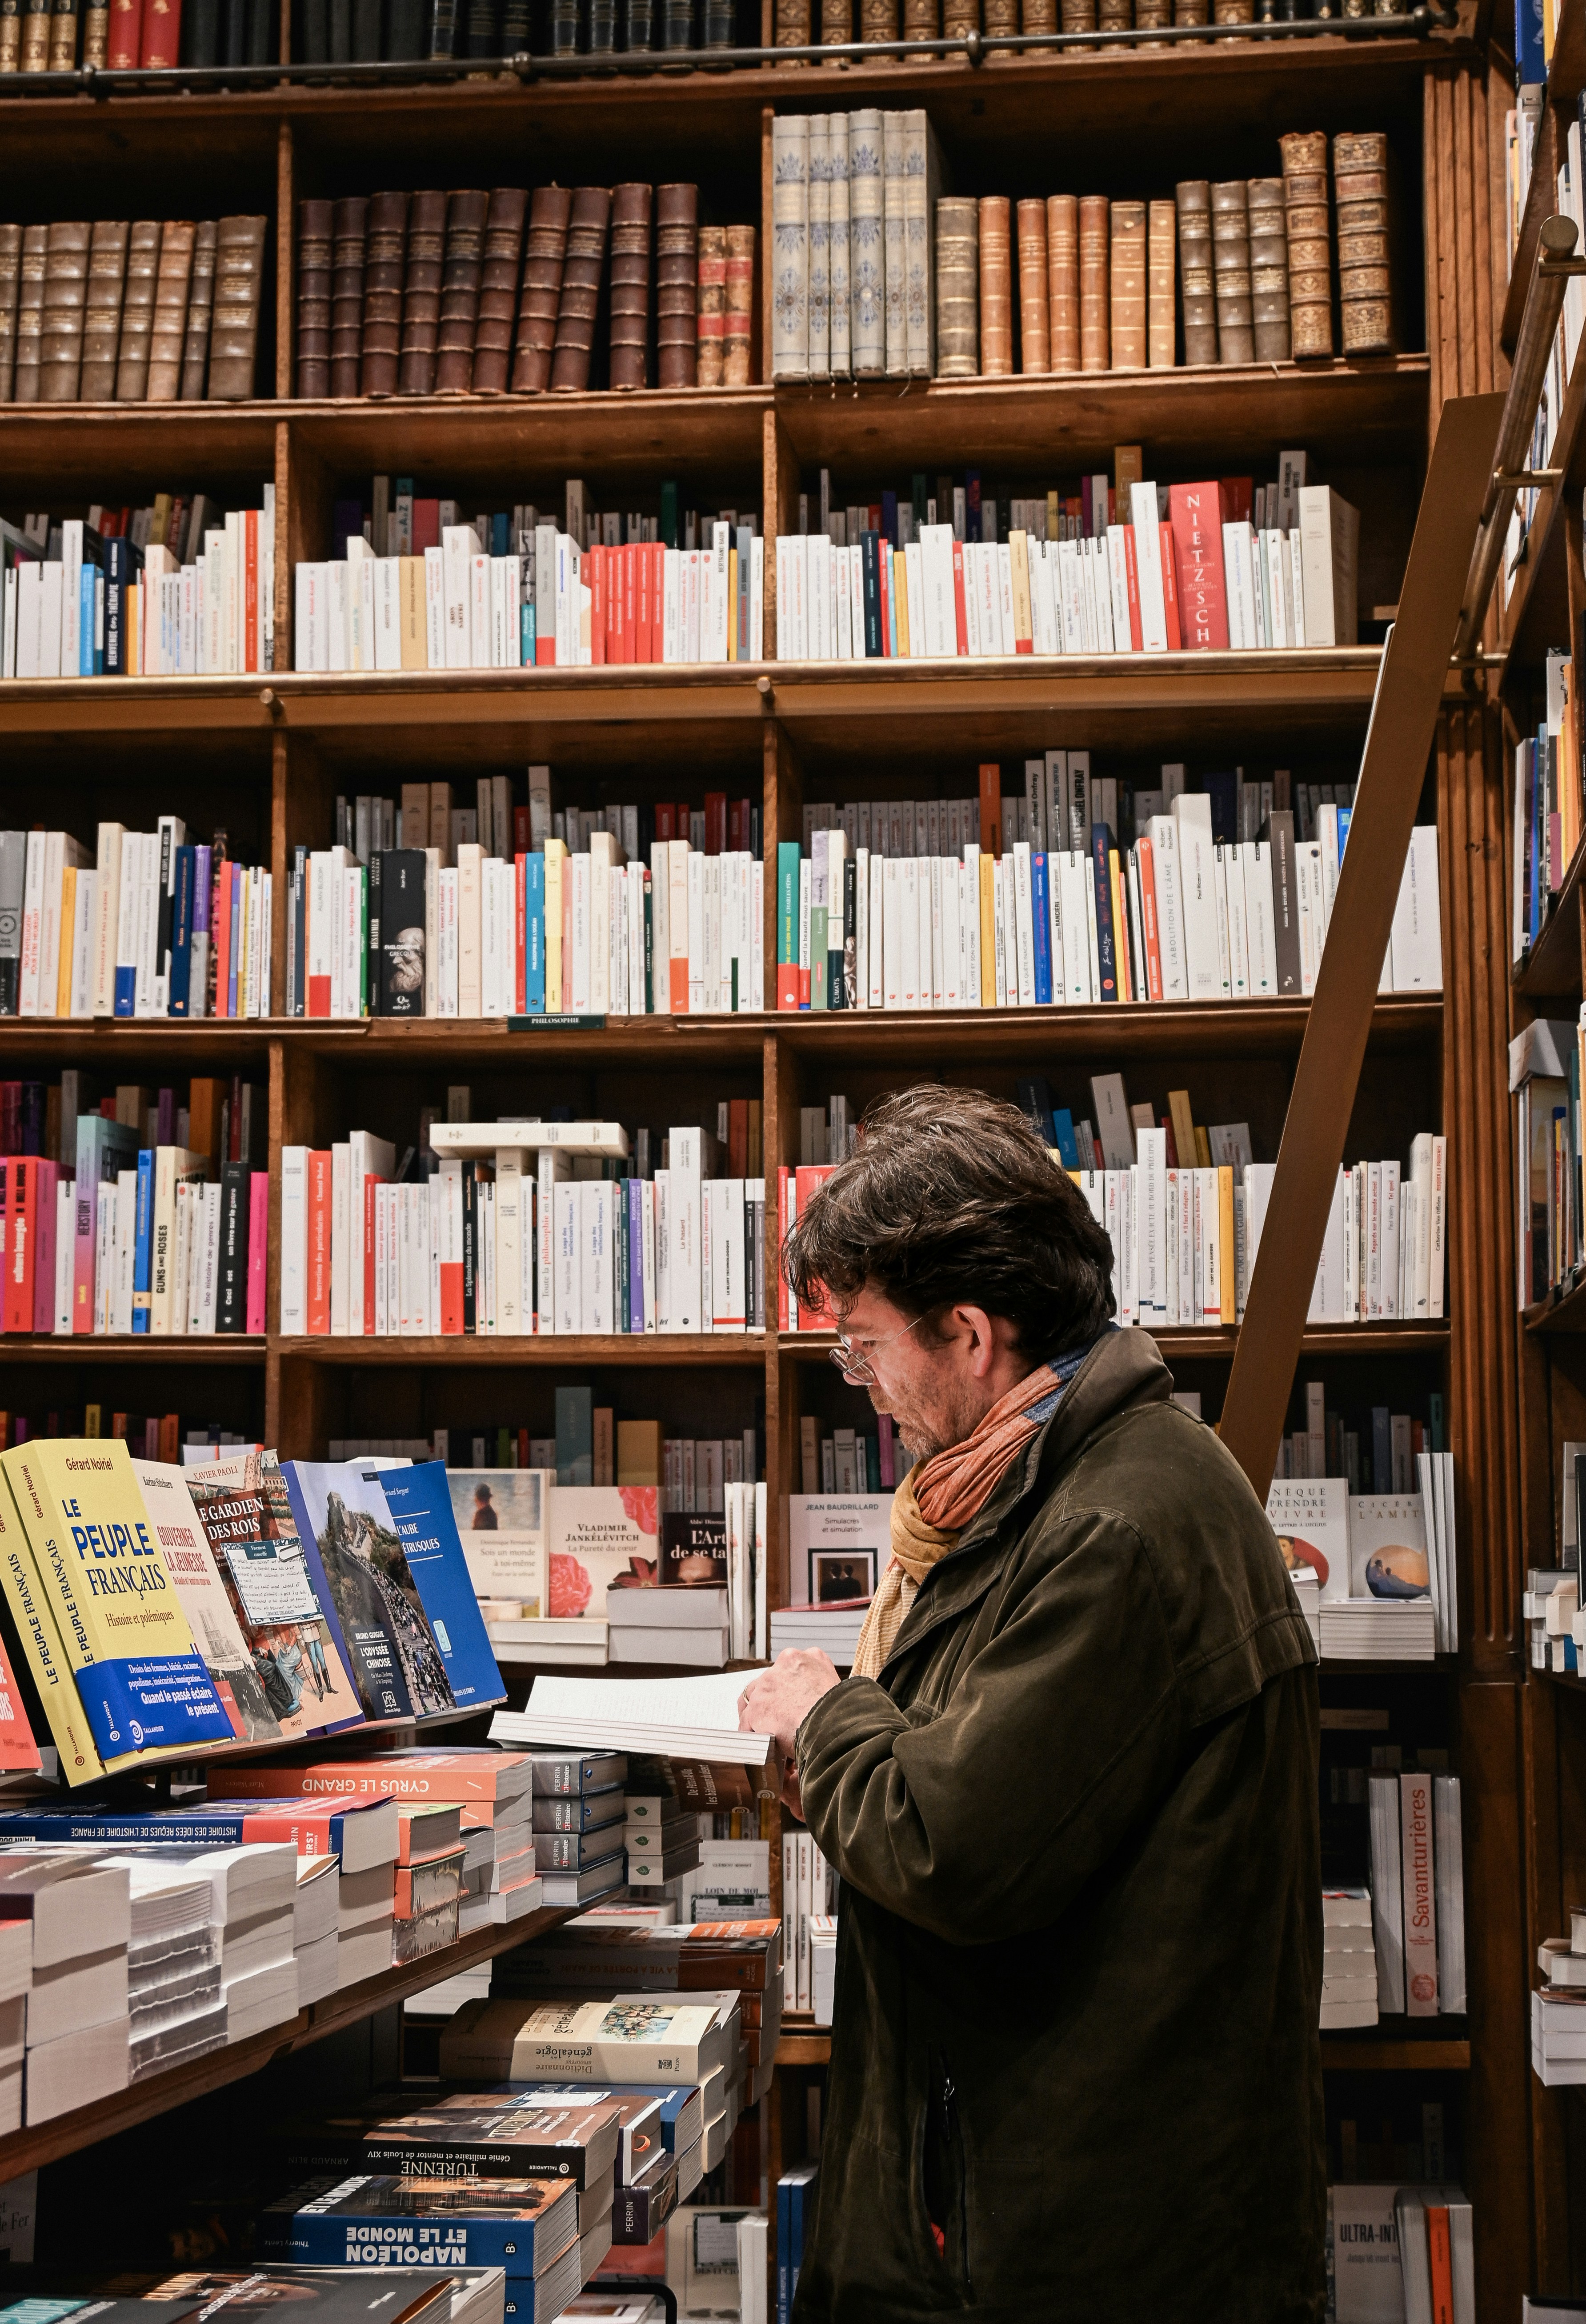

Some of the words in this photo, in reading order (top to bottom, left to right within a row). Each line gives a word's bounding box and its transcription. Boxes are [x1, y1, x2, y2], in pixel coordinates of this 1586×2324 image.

[1186, 494, 1210, 651] NIETZSCH
[108, 584, 119, 614] THÉRAPIE
[111, 615, 117, 629] en
[109, 630, 118, 666] BIENVENUE
[1164, 863, 1173, 889] L'ÂME
[1166, 893, 1173, 904] DE
[369, 919, 379, 949] DÉSAIMER
[1168, 906, 1178, 965] L'ABOLITION
[531, 1016, 580, 1025] PHILOSOPHIE
[543, 1157, 551, 1193] questions
[544, 1203, 549, 1213] en
[78, 1200, 90, 1236] HERSTORY
[157, 1225, 167, 1254] ROSES
[207, 1221, 215, 1246] genres
[541, 1215, 552, 1265] philosophie
[205, 1249, 213, 1259] de
[228, 1246, 235, 1255] un
[542, 1268, 549, 1276] la
[156, 1269, 166, 1293] GUNS
[204, 1292, 212, 1306] Une
[225, 1288, 233, 1305] Ceci
[66, 1457, 91, 1471] Gérard
[92, 1457, 113, 1470] Noiriel
[20, 1465, 35, 1492] Noiriel
[193, 1470, 217, 1480] XAVIER
[217, 1466, 238, 1476] PAOLI
[30, 1492, 44, 1519] Gérard
[62, 1499, 81, 1518] LE
[199, 1508, 208, 1522] E
[208, 1497, 264, 1520] GARDIEN
[1358, 1499, 1413, 1508] CICÉR
[207, 1523, 231, 1540] DES
[230, 1517, 260, 1536] ROIS
[396, 1523, 419, 1536] L'AUBE
[577, 1524, 628, 1532] VLADIMIR
[71, 1523, 155, 1560] PEUPLE
[157, 1526, 197, 1548] GOUVERNER
[565, 1532, 640, 1542] JANKÉLÉVITCH
[402, 1538, 440, 1553] ÉTRUSQUES
[671, 1546, 689, 1558] de
[693, 1550, 708, 1558] se
[712, 1548, 725, 1558] ta
[163, 1551, 175, 1571] LA
[175, 1552, 208, 1572] JEUNESSE
[45, 1539, 73, 1601] FRANÇAIS
[8, 1553, 36, 1615] FRANÇAIS
[86, 1564, 166, 1600] FRANÇAIS
[105, 1613, 133, 1628] Histoire
[134, 1614, 141, 1625] et
[142, 1609, 174, 1627] polémiques
[66, 1602, 90, 1656] PEUPLE
[27, 1616, 53, 1668] PEUPLE
[360, 1643, 389, 1657] L'ODYSSÉE
[366, 1657, 392, 1669] CHINOISE
[43, 1667, 60, 1685] LE
[141, 1690, 164, 1704] Quand
[164, 1690, 172, 1702] le
[172, 1688, 191, 1704] passé
[191, 1686, 212, 1700] éclaire
[103, 1700, 115, 1729] TALLANDIER
[185, 1704, 194, 1716] le
[194, 1702, 220, 1717] présent
[290, 1719, 302, 1728] PAYOT
[66, 1726, 79, 1755] TALLANDIER
[302, 1779, 356, 1792] GRAND
[360, 1779, 376, 1792] LE
[380, 1780, 429, 1792] CYRUS
[562, 1765, 570, 1793] L'Histoire
[71, 1828, 96, 1836] FRANCE
[97, 1828, 105, 1836] DE
[107, 1827, 139, 1836] L'HISTOIRE
[140, 1827, 149, 1836] DE
[150, 1825, 174, 1836] REÇUES
[176, 1827, 193, 1838] IDÉES
[195, 1827, 207, 1836] DES
[209, 1827, 236, 1836] HISTOIRE
[561, 1839, 569, 1867] L'Histoire
[1409, 1788, 1430, 1928] Savanturières
[536, 2045, 593, 2059] généalogie
[536, 2065, 592, 2073] Dictionnaire
[455, 2153, 487, 2161] militaire
[401, 2161, 478, 2176] TURENNE
[346, 2227, 413, 2242] MONDE
[420, 2228, 440, 2242] LE
[445, 2228, 467, 2243] ET
[1340, 2224, 1396, 2242] ULTRA-INT
[284, 2240, 309, 2248] Thierry
[346, 2245, 466, 2266] NAPOLÉON
